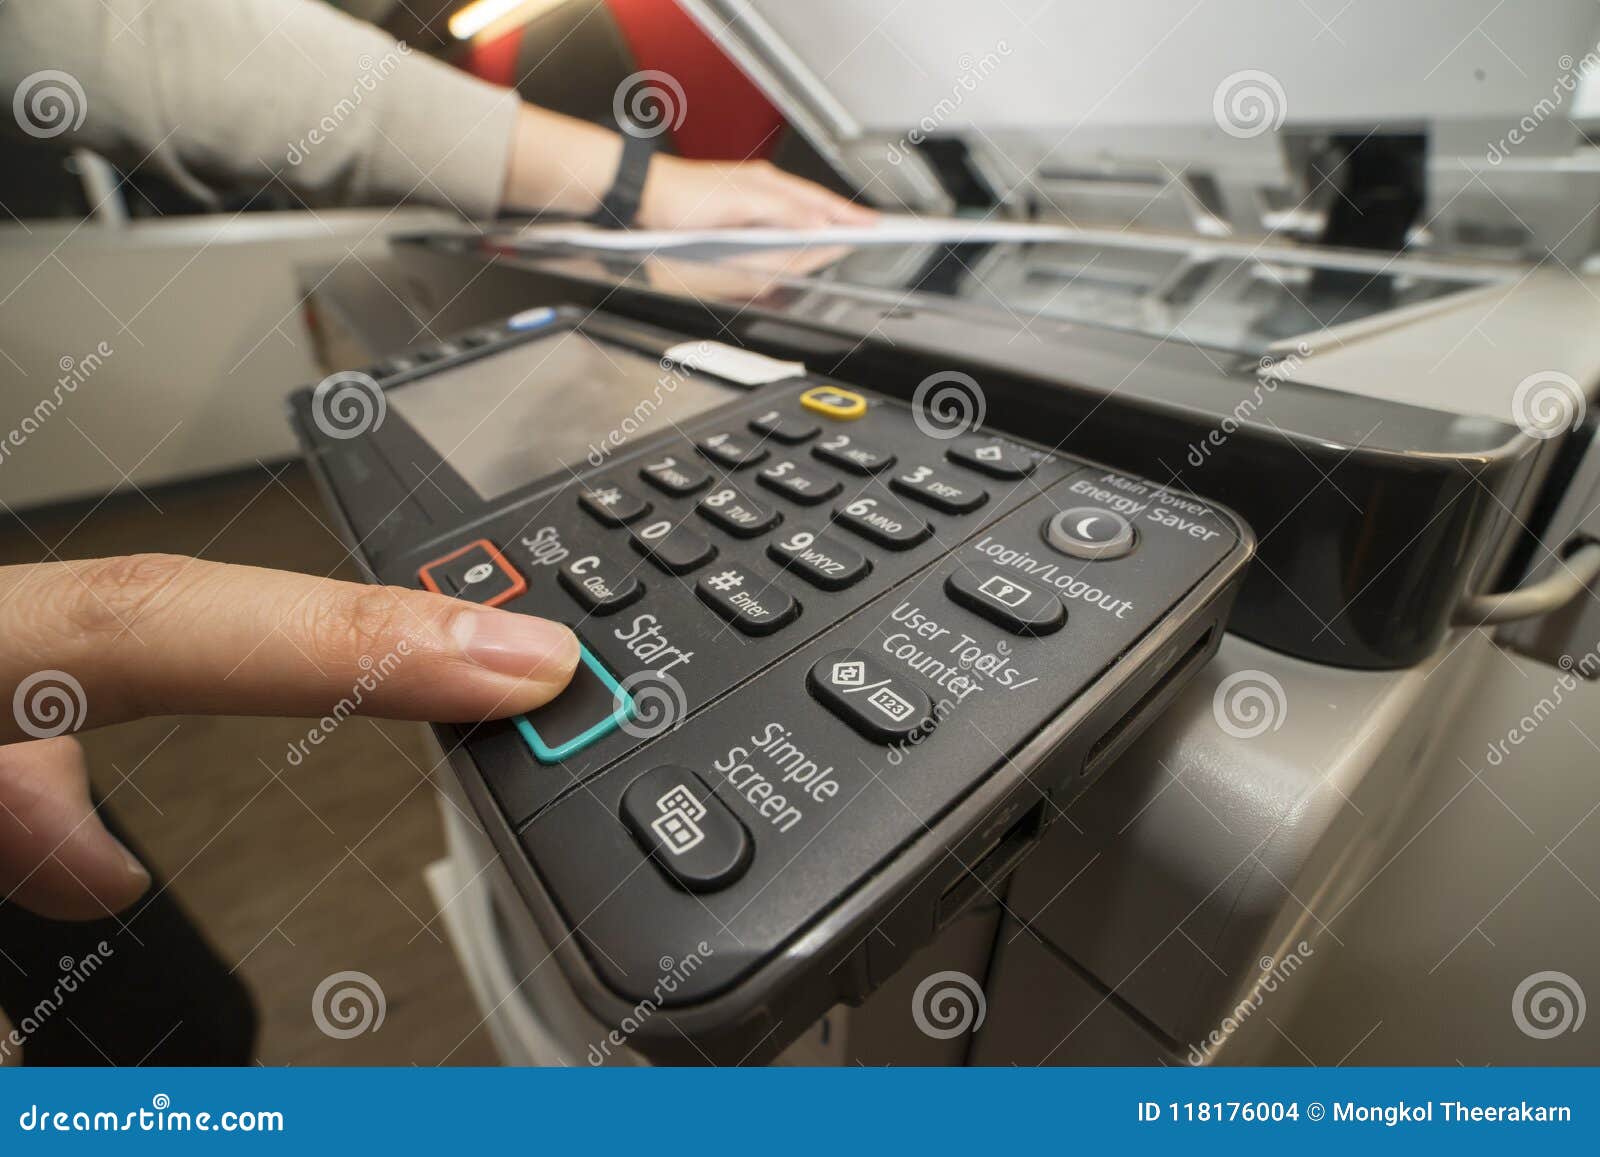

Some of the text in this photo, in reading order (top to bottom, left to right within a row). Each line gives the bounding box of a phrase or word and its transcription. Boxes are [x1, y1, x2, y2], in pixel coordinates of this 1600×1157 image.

[757, 411, 779, 424] 1
[821, 434, 850, 450] 2
[648, 456, 676, 471] 7
[764, 461, 795, 477] 5
[901, 465, 963, 498] 3 DEF
[705, 489, 758, 523] 8 TUV
[1069, 480, 1220, 541] Energy Saver
[1100, 473, 1214, 517] Main Power
[640, 521, 672, 539] 0
[846, 498, 902, 533] 6 MNO
[521, 526, 570, 566] Stop
[780, 532, 845, 575] 9 WXYZ
[583, 576, 614, 600] Clear
[708, 570, 769, 617] # Enter
[974, 536, 1134, 619] Login/Logout
[614, 614, 694, 679] Start
[883, 633, 984, 699] Counter
[891, 602, 1039, 690] User Tools/
[878, 691, 904, 714] 123
[751, 722, 840, 803] Simple
[714, 746, 803, 833] Screen
